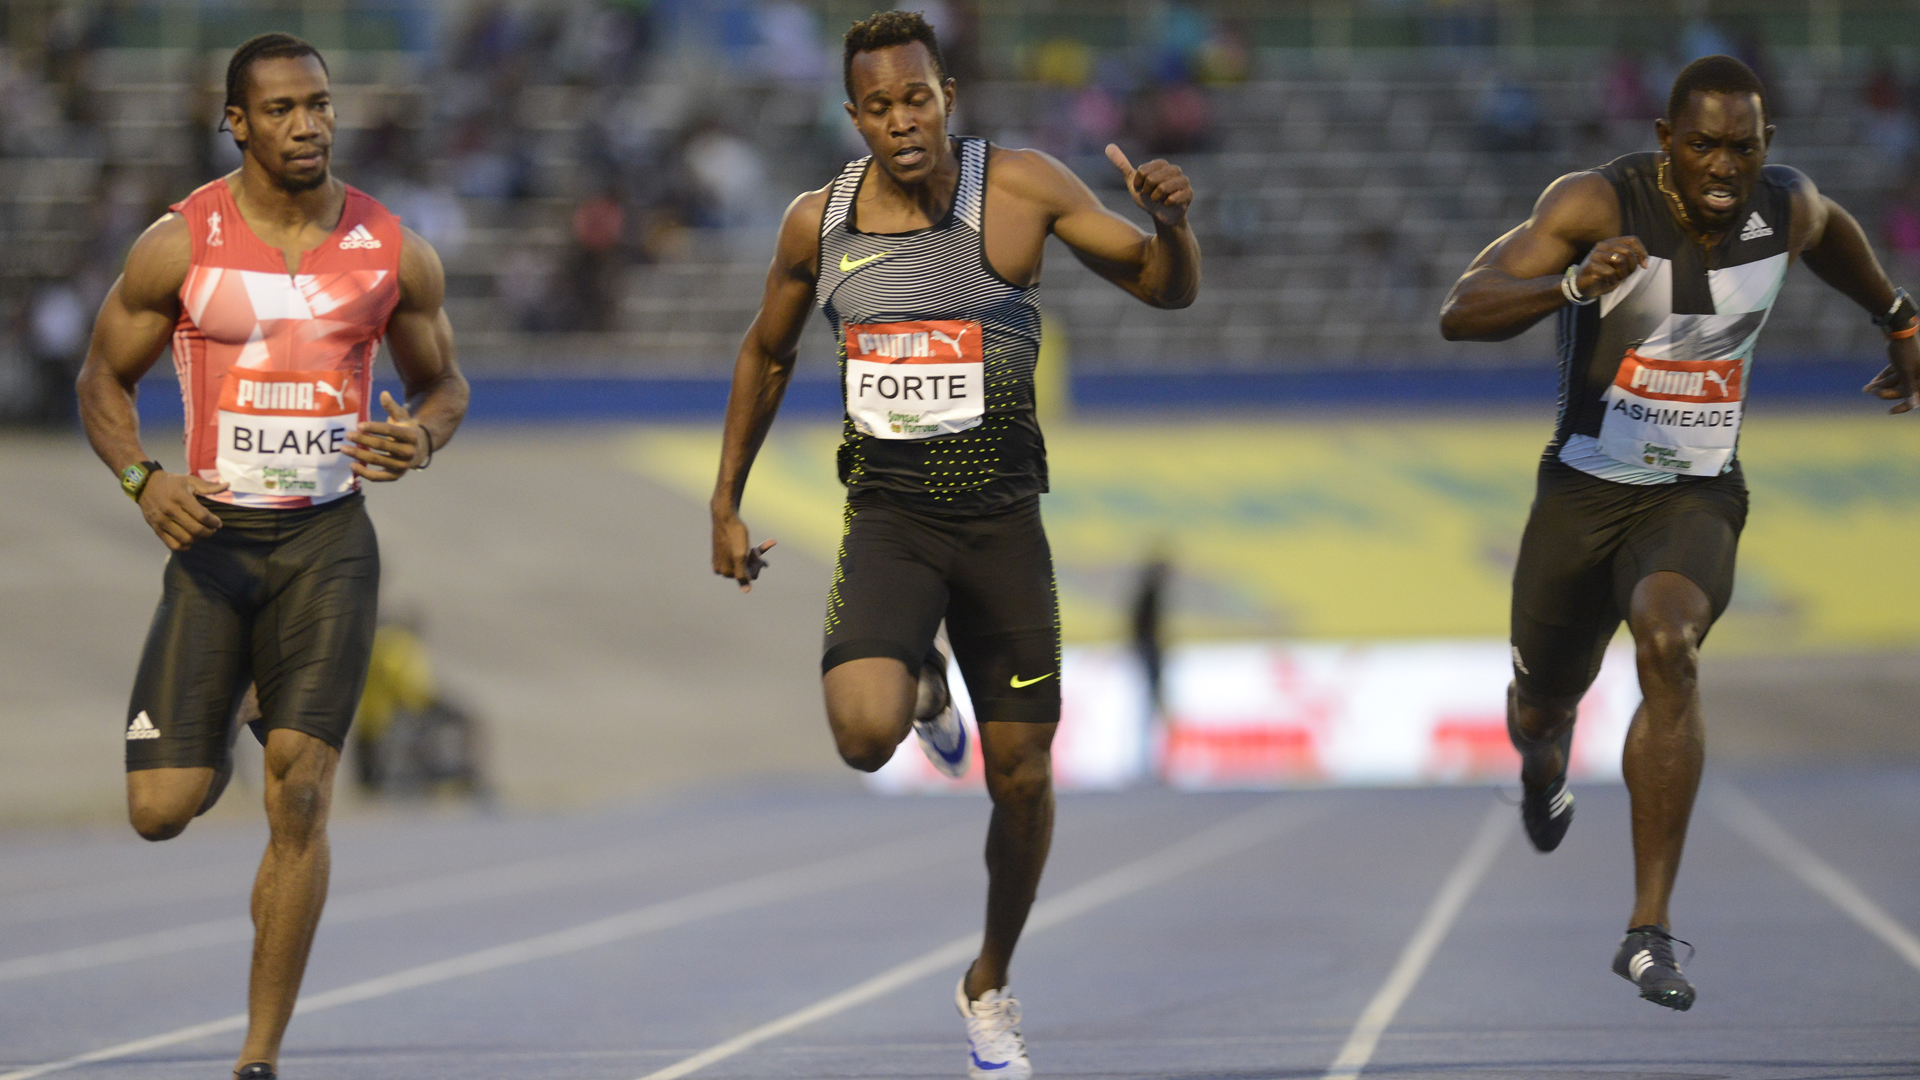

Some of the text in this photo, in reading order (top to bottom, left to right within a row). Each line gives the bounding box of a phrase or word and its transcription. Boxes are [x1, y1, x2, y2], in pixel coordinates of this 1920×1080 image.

[857, 332, 929, 358] PUMA
[236, 379, 314, 410] PUMA
[859, 373, 967, 400] FORTE
[1630, 365, 1704, 396] PUMA
[1613, 398, 1734, 428] ASHMEADE
[233, 426, 346, 455] BLAKE
